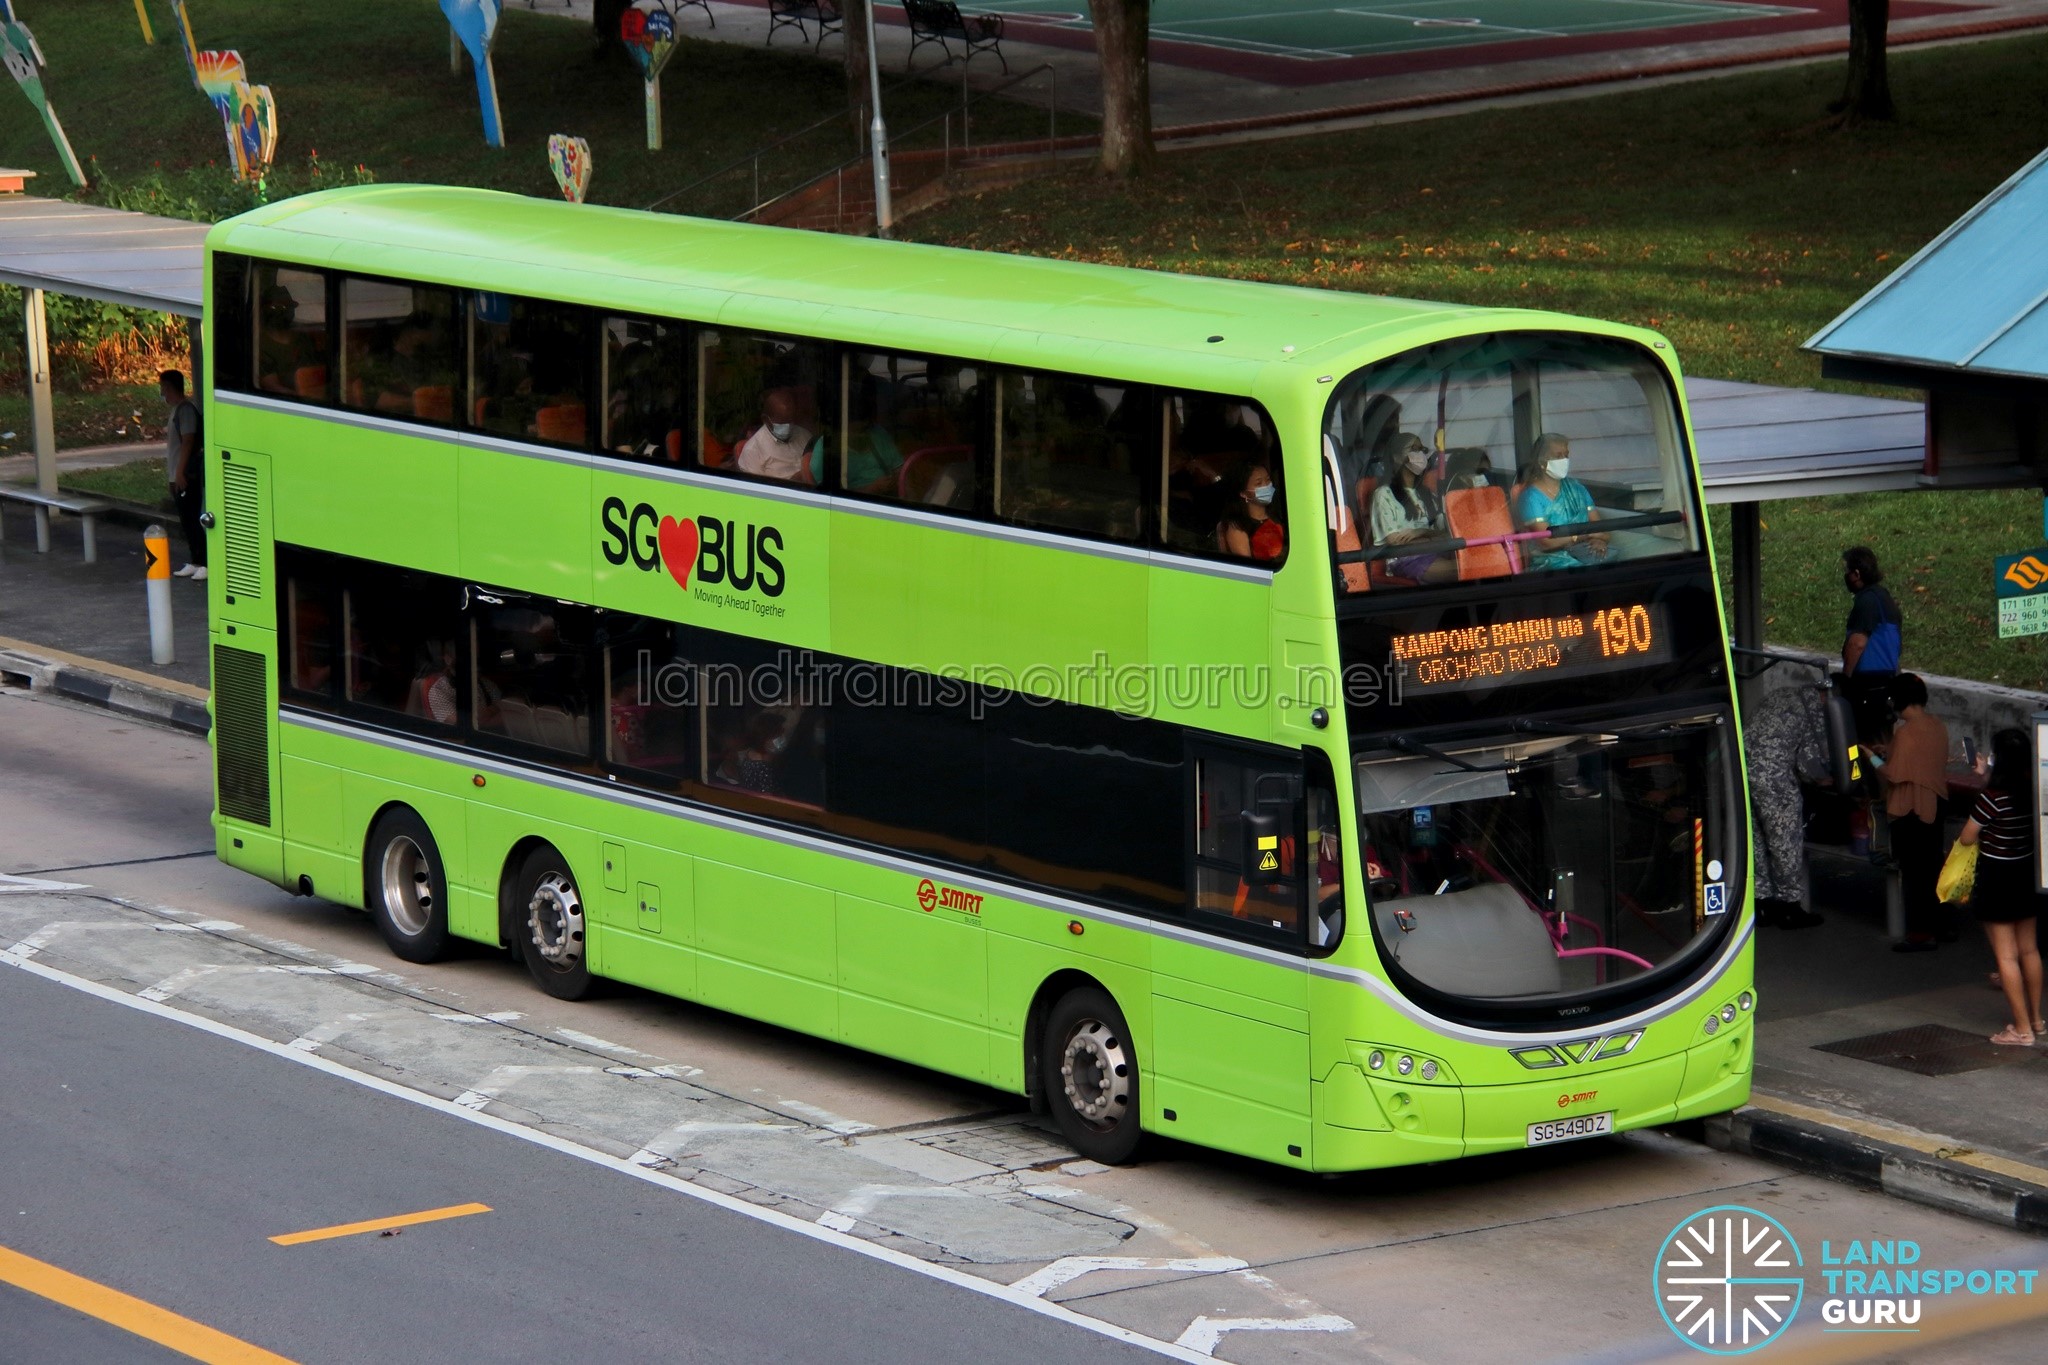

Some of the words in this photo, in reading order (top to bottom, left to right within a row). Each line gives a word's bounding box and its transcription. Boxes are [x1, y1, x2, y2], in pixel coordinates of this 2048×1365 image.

[602, 496, 661, 573] SG
[697, 515, 785, 597] BUS
[694, 587, 722, 608] Moving
[724, 595, 750, 611] Ahead
[751, 600, 786, 618] Together
[2002, 600, 2017, 610] 171
[2022, 597, 2037, 608] 187
[2002, 613, 2017, 623] 722
[2022, 610, 2038, 620] 960
[1393, 626, 1487, 659] KAMPONG
[1492, 617, 1553, 648] BAHRU
[1557, 615, 1584, 638] via
[1593, 604, 1652, 656] 190
[2001, 625, 2018, 636] 963e
[1418, 654, 1505, 684] ORCHARD
[1510, 644, 1561, 672] ROAD
[939, 887, 984, 914] SMRT
[1558, 1006, 1591, 1017] VOLVO
[1570, 1091, 1598, 1103] SMRT
[1534, 1115, 1605, 1141] SG5490Z
